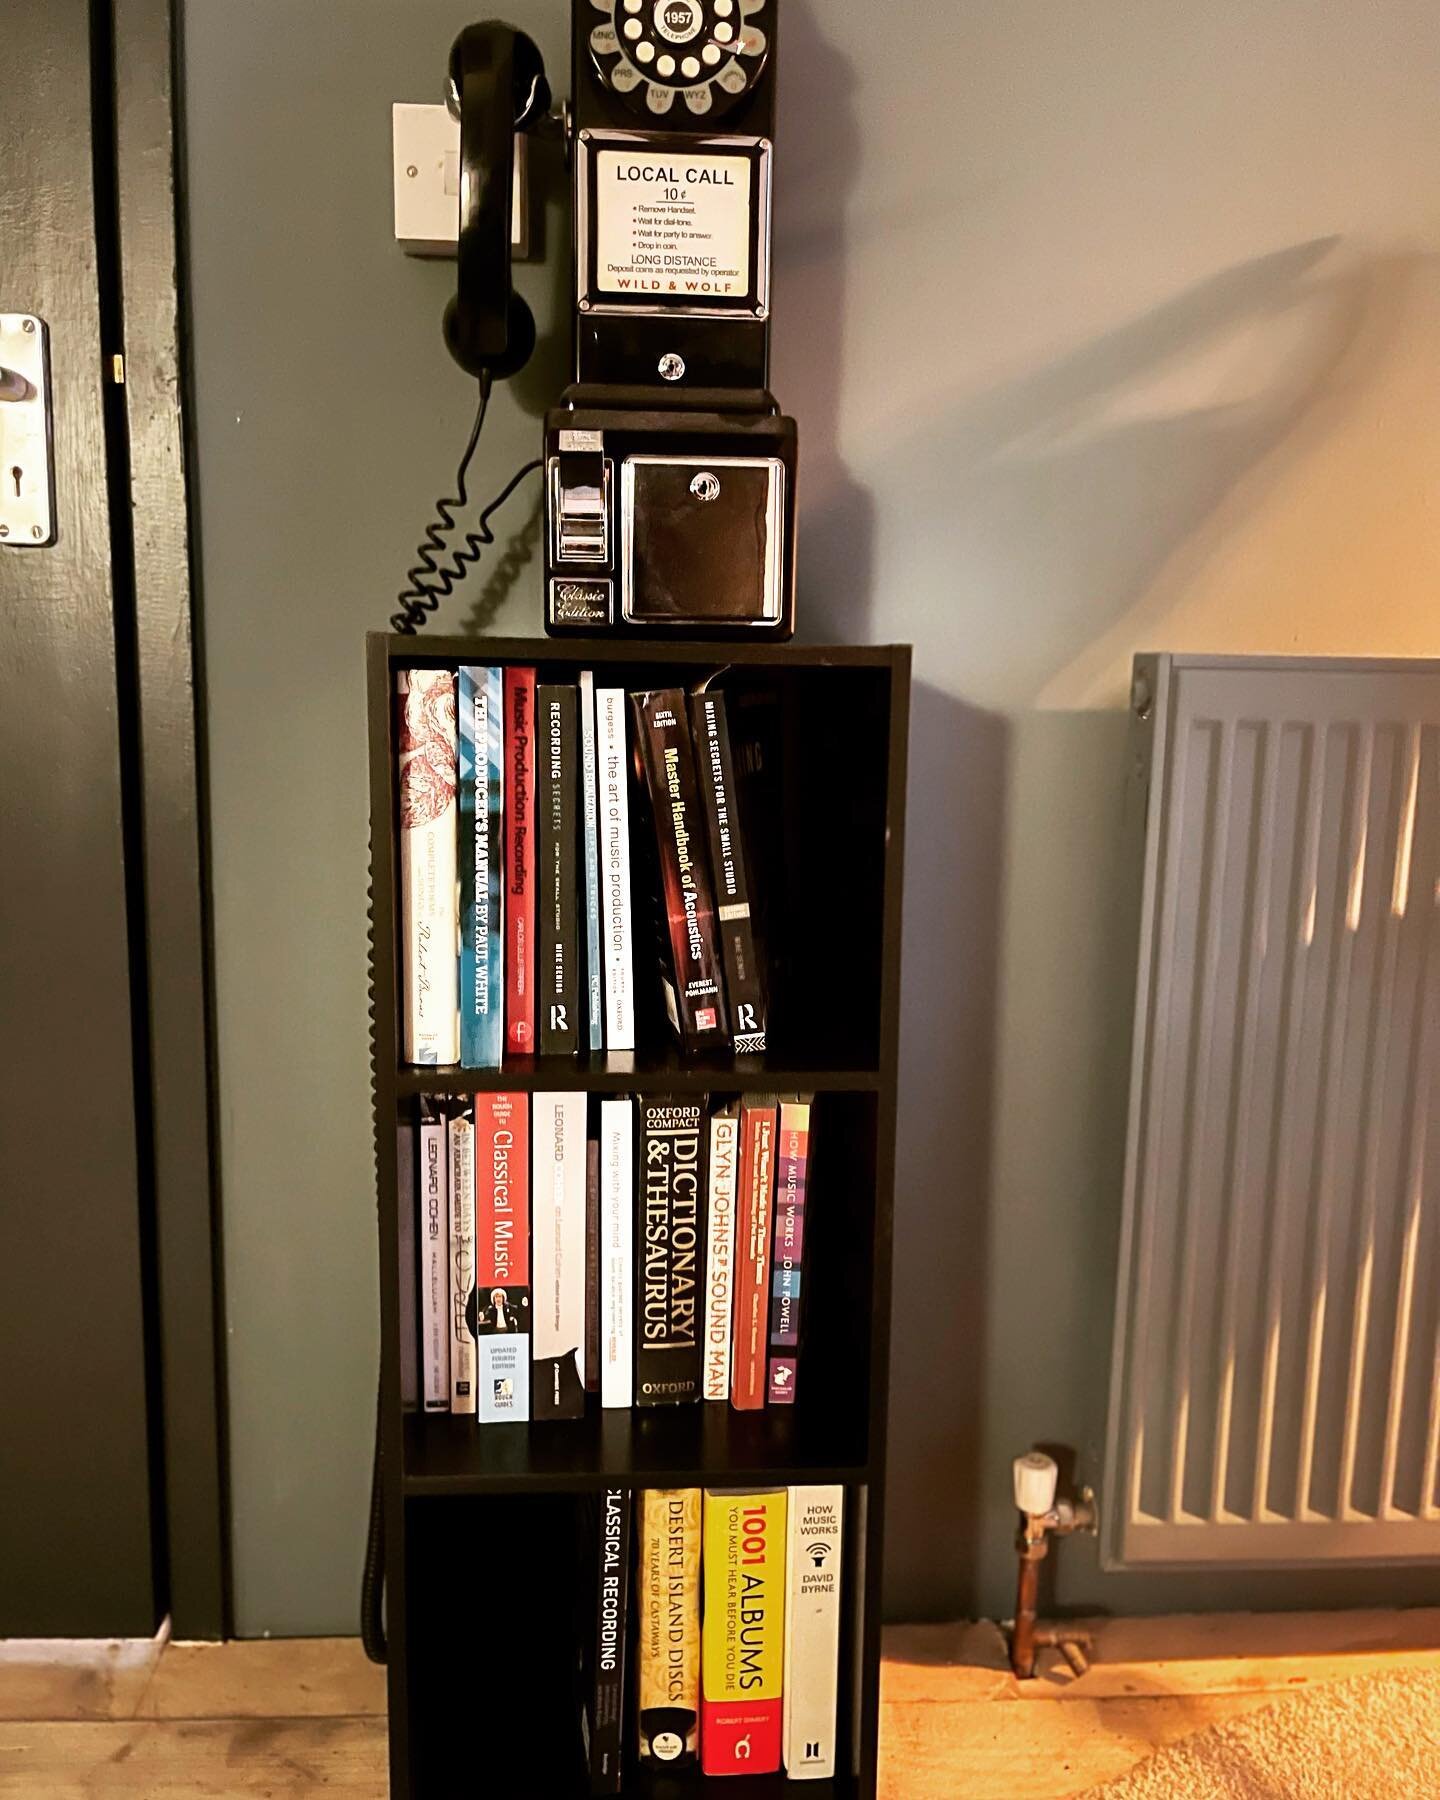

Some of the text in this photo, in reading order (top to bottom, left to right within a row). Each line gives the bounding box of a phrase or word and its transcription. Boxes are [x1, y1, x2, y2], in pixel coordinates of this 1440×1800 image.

[665, 12, 692, 24] 1957
[651, 90, 669, 99] TUV
[686, 90, 706, 99] WYZ
[617, 165, 734, 185] LOCAL CALL
[638, 205, 666, 214] Remove
[638, 242, 654, 250] Drop
[663, 230, 680, 239] party
[681, 230, 688, 238] to
[608, 264, 633, 273] Deposit
[665, 267, 699, 276] requested
[701, 267, 709, 276] by
[631, 254, 717, 267] LONG DISTANCE
[618, 279, 732, 293] WILD & WOLF
[557, 584, 605, 601] Classic
[557, 601, 605, 619] Edition
[704, 701, 719, 737] MIXING
[550, 702, 562, 778] RECORDING
[584, 729, 593, 769] SOUND
[709, 741, 723, 782] SECRETS
[512, 686, 528, 895] Music Recording
[714, 785, 725, 804] FOR
[552, 783, 561, 830] SECRETS
[716, 807, 728, 825] THE
[606, 697, 624, 951] burgess the art of music production
[474, 696, 488, 1015] THE PRODUCER'S MANUAL BY PAUL WHITE
[664, 747, 704, 960] Master Handbook of Acoustics
[719, 828, 733, 858] SMALL
[724, 861, 737, 895] STUDIO
[417, 921, 431, 970] Robert
[554, 944, 564, 994] MIKE SENIOR
[417, 974, 431, 1019] Burns
[685, 986, 718, 998] POHLMANN
[688, 979, 713, 989] EVEREST
[591, 990, 600, 1025] Publishing
[646, 1107, 700, 1119] OXFORD
[646, 1118, 700, 1129] COMPACT
[454, 1133, 461, 1145] AN
[554, 1104, 564, 1162] LEONARD
[428, 1138, 439, 1240] LEONARD COHEN
[609, 1132, 622, 1249] Mixing with your mind
[784, 1132, 798, 1247] HOW MUSIC WORKS
[454, 1193, 462, 1218] GUIDE
[493, 1131, 513, 1278] Classical Music
[454, 1221, 462, 1232] TO
[671, 1137, 698, 1337] DICTIONARY
[708, 1124, 732, 1396] GLYN JOHNS SOUND MAN
[779, 1255, 793, 1334] JOHN POWELL
[490, 1346, 517, 1354] UPDATED
[643, 1382, 695, 1395] OXFORD
[803, 1515, 837, 1525] MUSIC
[807, 1505, 833, 1515] HOW
[800, 1526, 838, 1535] WORKS
[801, 1584, 835, 1594] BYRNE
[802, 1574, 834, 1584] DAVID
[650, 1538, 660, 1658] 70 YEARS OF CASTAWAYS
[668, 1501, 684, 1702] DESERT ISLAND DISCS
[725, 1506, 738, 1691] YOU MUST HEAR BEFORE YOU DIE
[739, 1505, 766, 1690] 1001 ALBUMS
[600, 1576, 619, 1670] RECORDING
